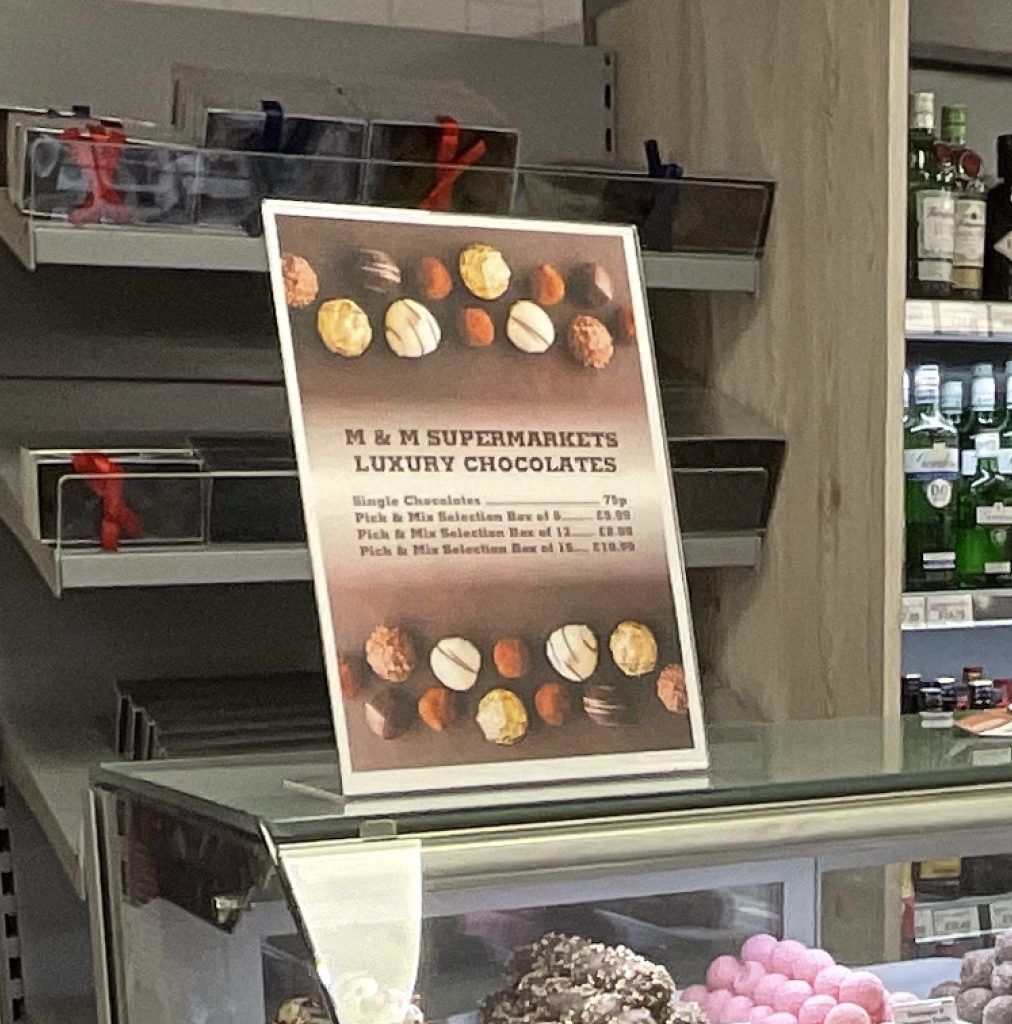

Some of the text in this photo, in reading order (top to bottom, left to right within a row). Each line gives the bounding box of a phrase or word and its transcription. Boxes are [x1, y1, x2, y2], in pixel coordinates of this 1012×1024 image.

[345, 428, 618, 447] M & M SUPERMARKETS
[354, 455, 617, 473] LUXURY CHOCOLATES
[353, 495, 399, 509] Single
[403, 495, 481, 506] Chocolates
[355, 512, 387, 522] Pick
[408, 512, 434, 522] Mix
[438, 511, 503, 522] Selection
[507, 511, 532, 521] Box
[537, 510, 549, 521] of
[358, 528, 389, 540] Pick
[411, 528, 436, 539] Mix
[440, 527, 504, 538] Selection
[509, 527, 534, 537] Box
[538, 526, 551, 537] of
[360, 545, 392, 556] Pick
[413, 544, 438, 555] Mix
[442, 544, 506, 554] Selection
[512, 543, 536, 553] Box
[541, 542, 553, 553] of
